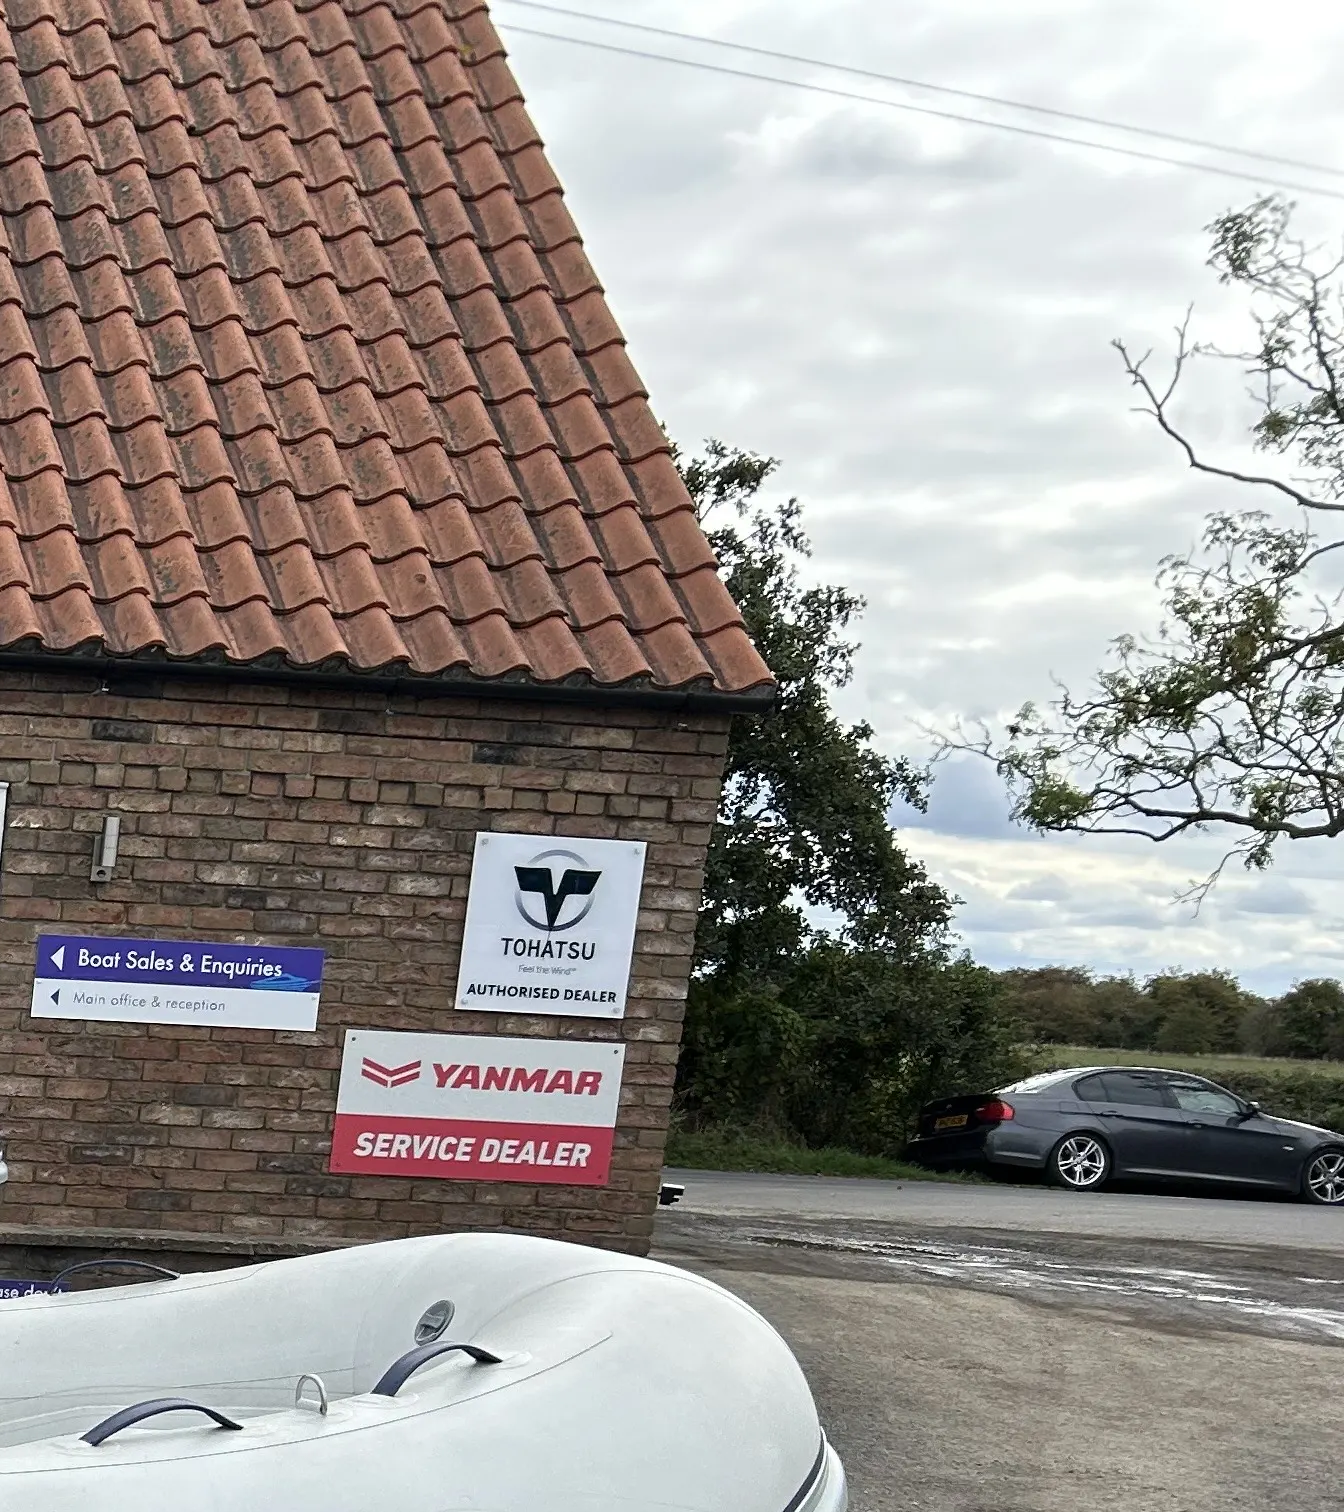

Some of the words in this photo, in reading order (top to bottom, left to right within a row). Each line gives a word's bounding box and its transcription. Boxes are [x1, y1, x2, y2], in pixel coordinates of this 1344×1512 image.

[501, 937, 596, 960] TOHATSU
[78, 949, 121, 968] Boat
[125, 950, 174, 971] Sales
[179, 954, 195, 972] &
[200, 955, 283, 980] Enquiries
[73, 992, 106, 1005] Main
[110, 994, 146, 1008] office
[151, 997, 161, 1008] &
[165, 998, 226, 1013] reception
[467, 984, 560, 1000] AUTHORISED
[563, 989, 617, 1003] DEALER
[432, 1063, 602, 1096] YANMAR
[353, 1132, 475, 1162] SERVICE
[479, 1138, 591, 1168] DEALER
